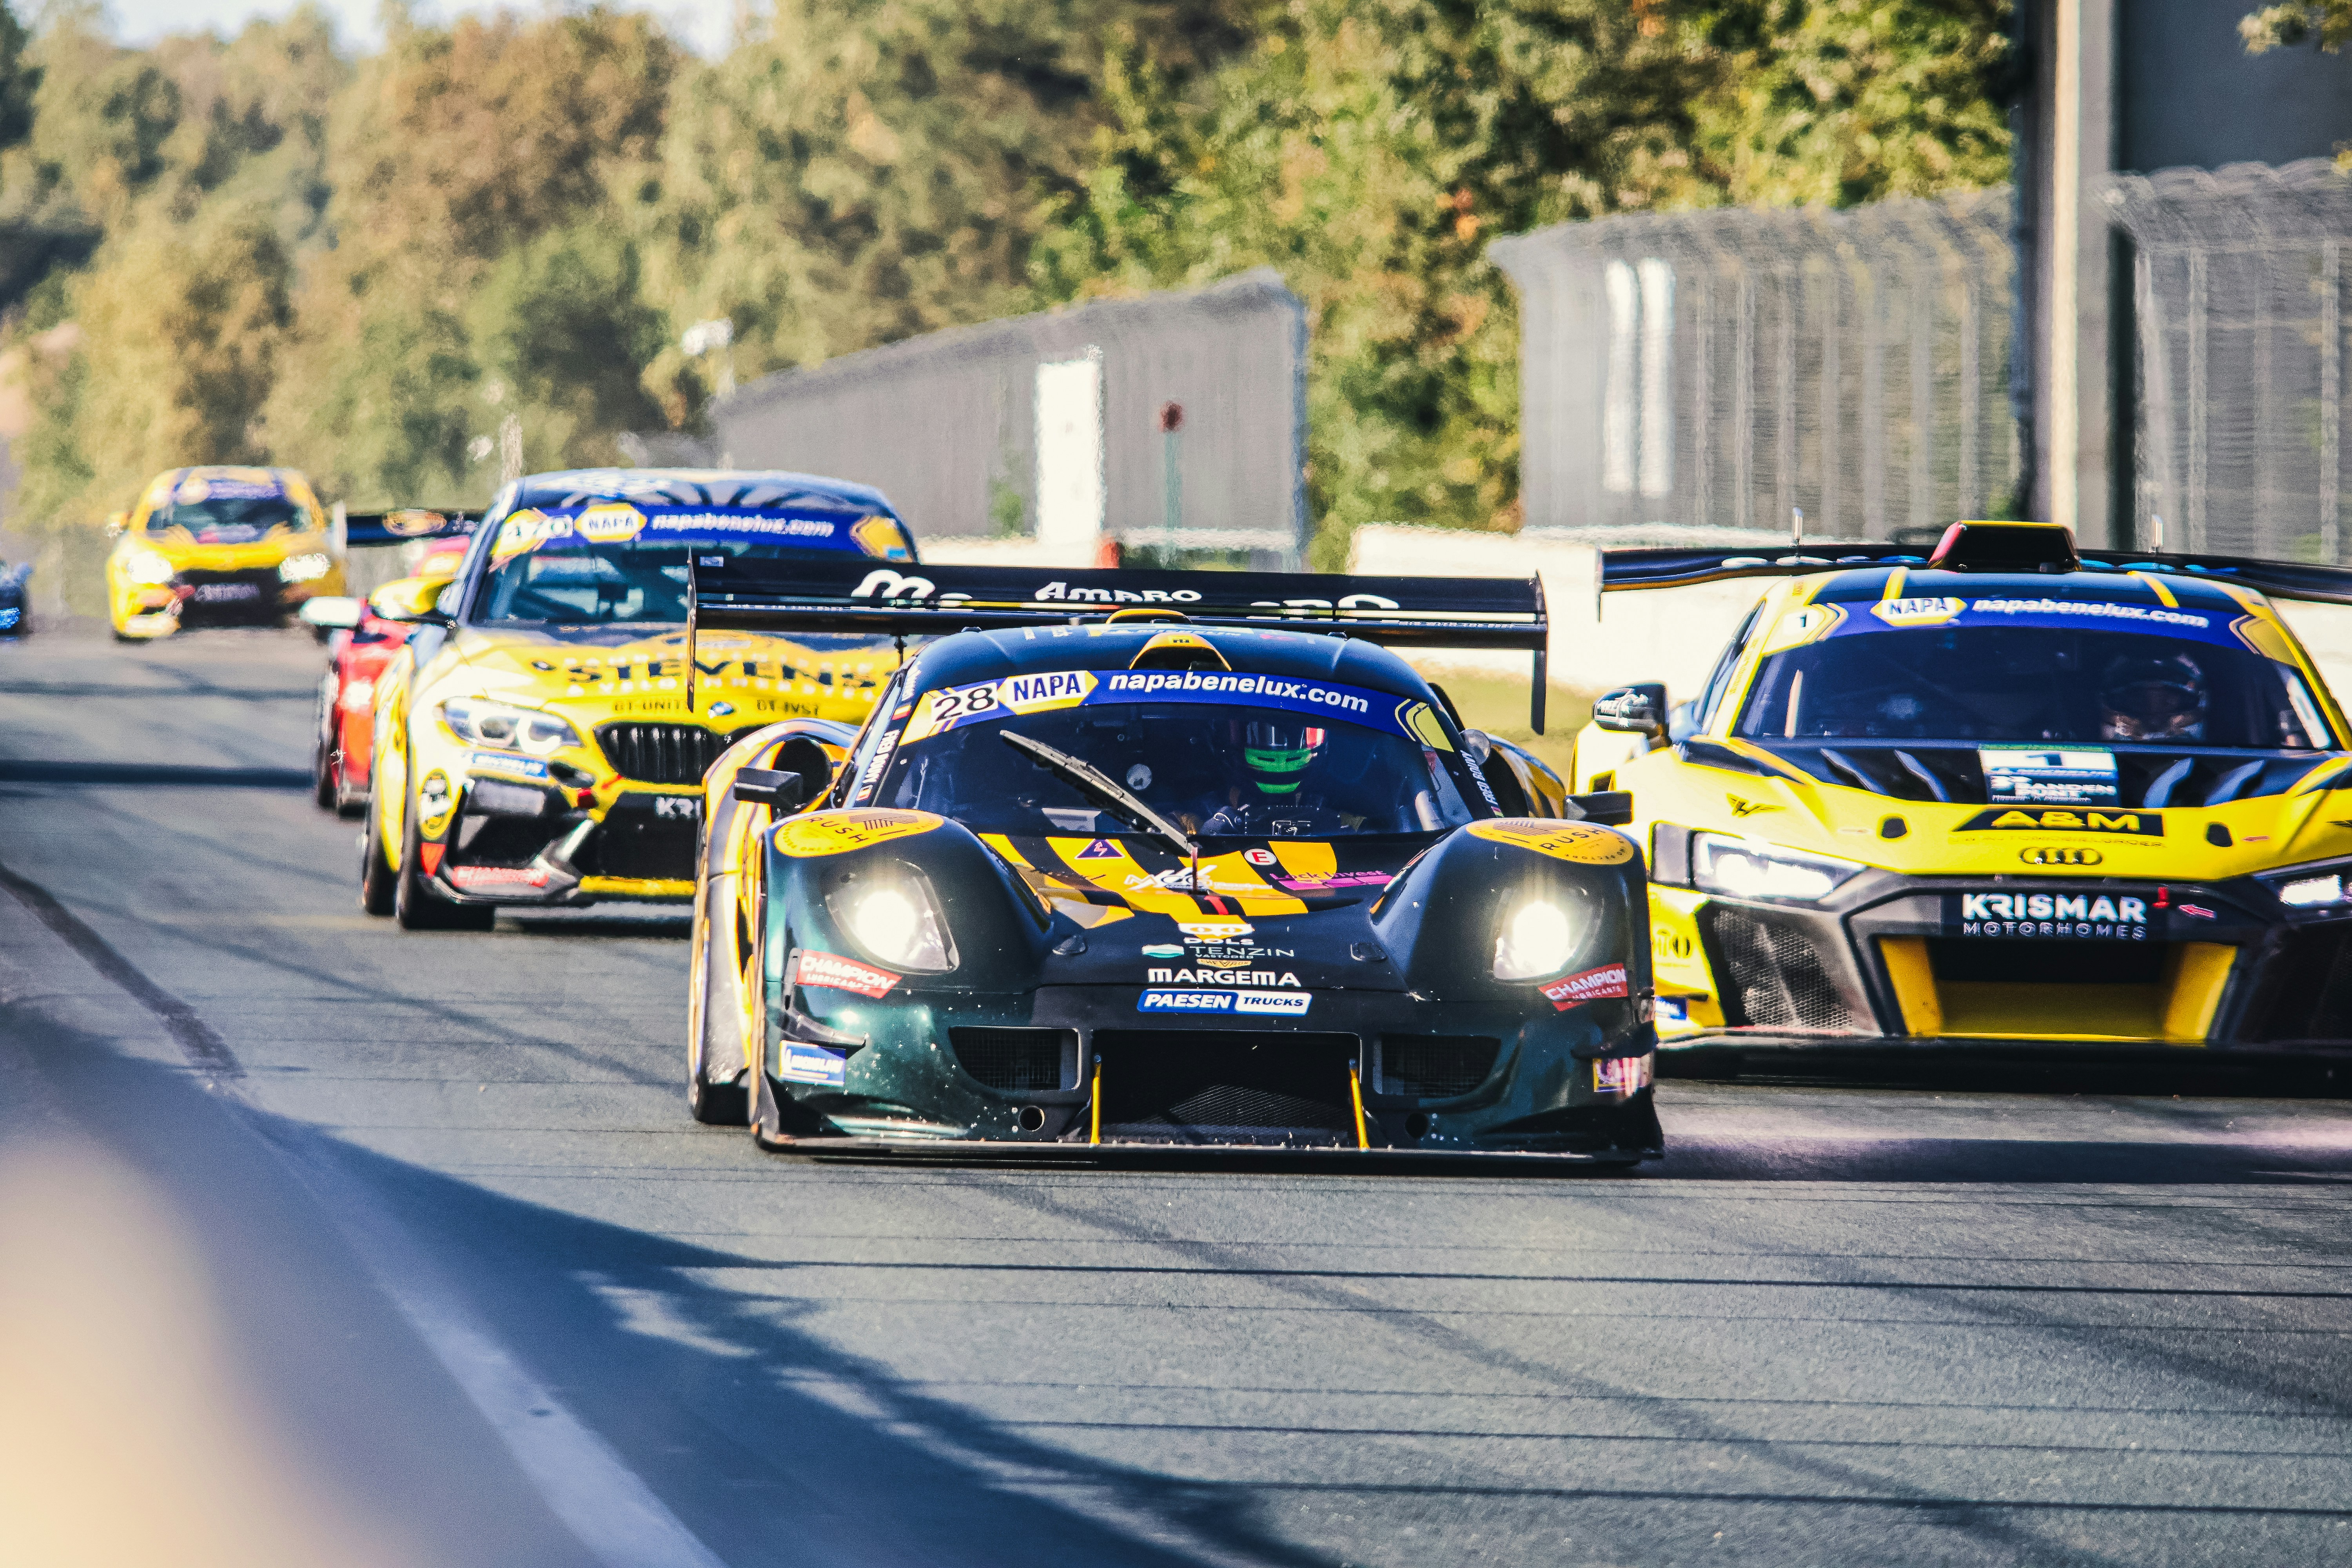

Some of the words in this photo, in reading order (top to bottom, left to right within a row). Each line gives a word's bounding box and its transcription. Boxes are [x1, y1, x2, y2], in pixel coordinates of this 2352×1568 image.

[588, 515, 633, 530] NAPA
[652, 512, 835, 537] napabenelux.com
[1888, 598, 1948, 614] NAPA
[1972, 597, 2209, 628] napabenelux.com
[569, 659, 876, 688] STEVENS
[1013, 673, 1081, 701] NAPA
[1109, 671, 1368, 712] napabenelux.com
[933, 686, 995, 721] 28
[804, 817, 869, 843] RUSH
[1992, 811, 2140, 831] A&M
[1539, 828, 1606, 850] RUSH
[1252, 852, 1270, 863] E
[1962, 893, 2147, 924] KRISMAR
[1183, 937, 1254, 946] DOLS
[1963, 922, 2147, 941] MOTORHOMES
[1189, 946, 1294, 957] TENZIN
[800, 955, 897, 990] CHAMPION
[1148, 967, 1301, 987] MARGEMA
[1545, 969, 1626, 1000] CHAMPION
[1144, 993, 1232, 1009] PAESEN
[1243, 996, 1304, 1007] TRUCKS
